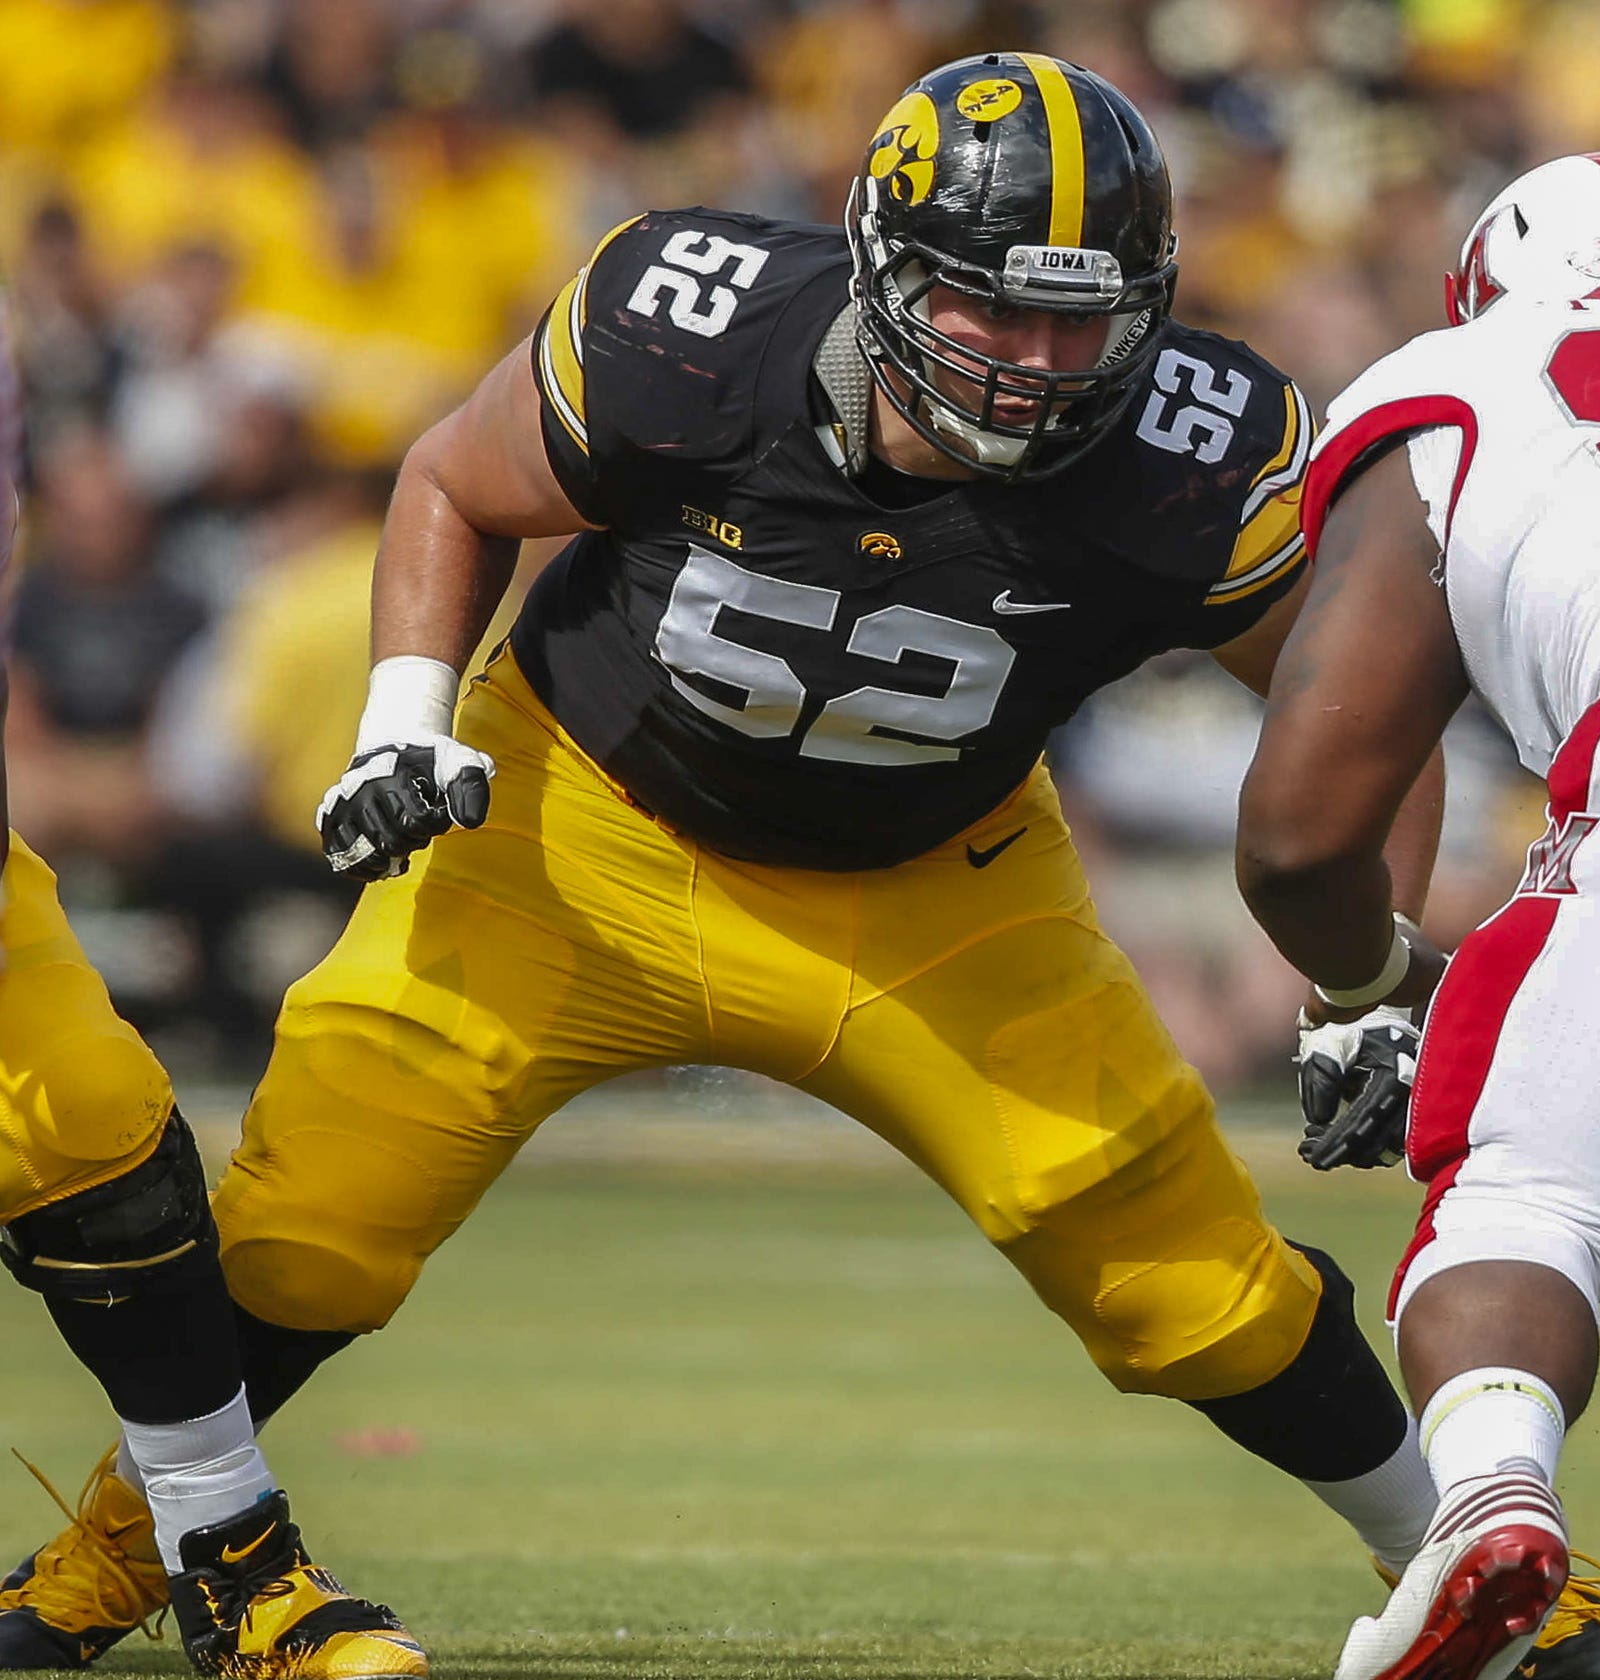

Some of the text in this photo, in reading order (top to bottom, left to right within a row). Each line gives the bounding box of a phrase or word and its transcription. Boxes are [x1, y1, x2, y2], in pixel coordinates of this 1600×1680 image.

[627, 230, 771, 338] 52
[1040, 251, 1086, 270] IOWA
[1136, 349, 1251, 464] 52
[650, 541, 1017, 766] 52
